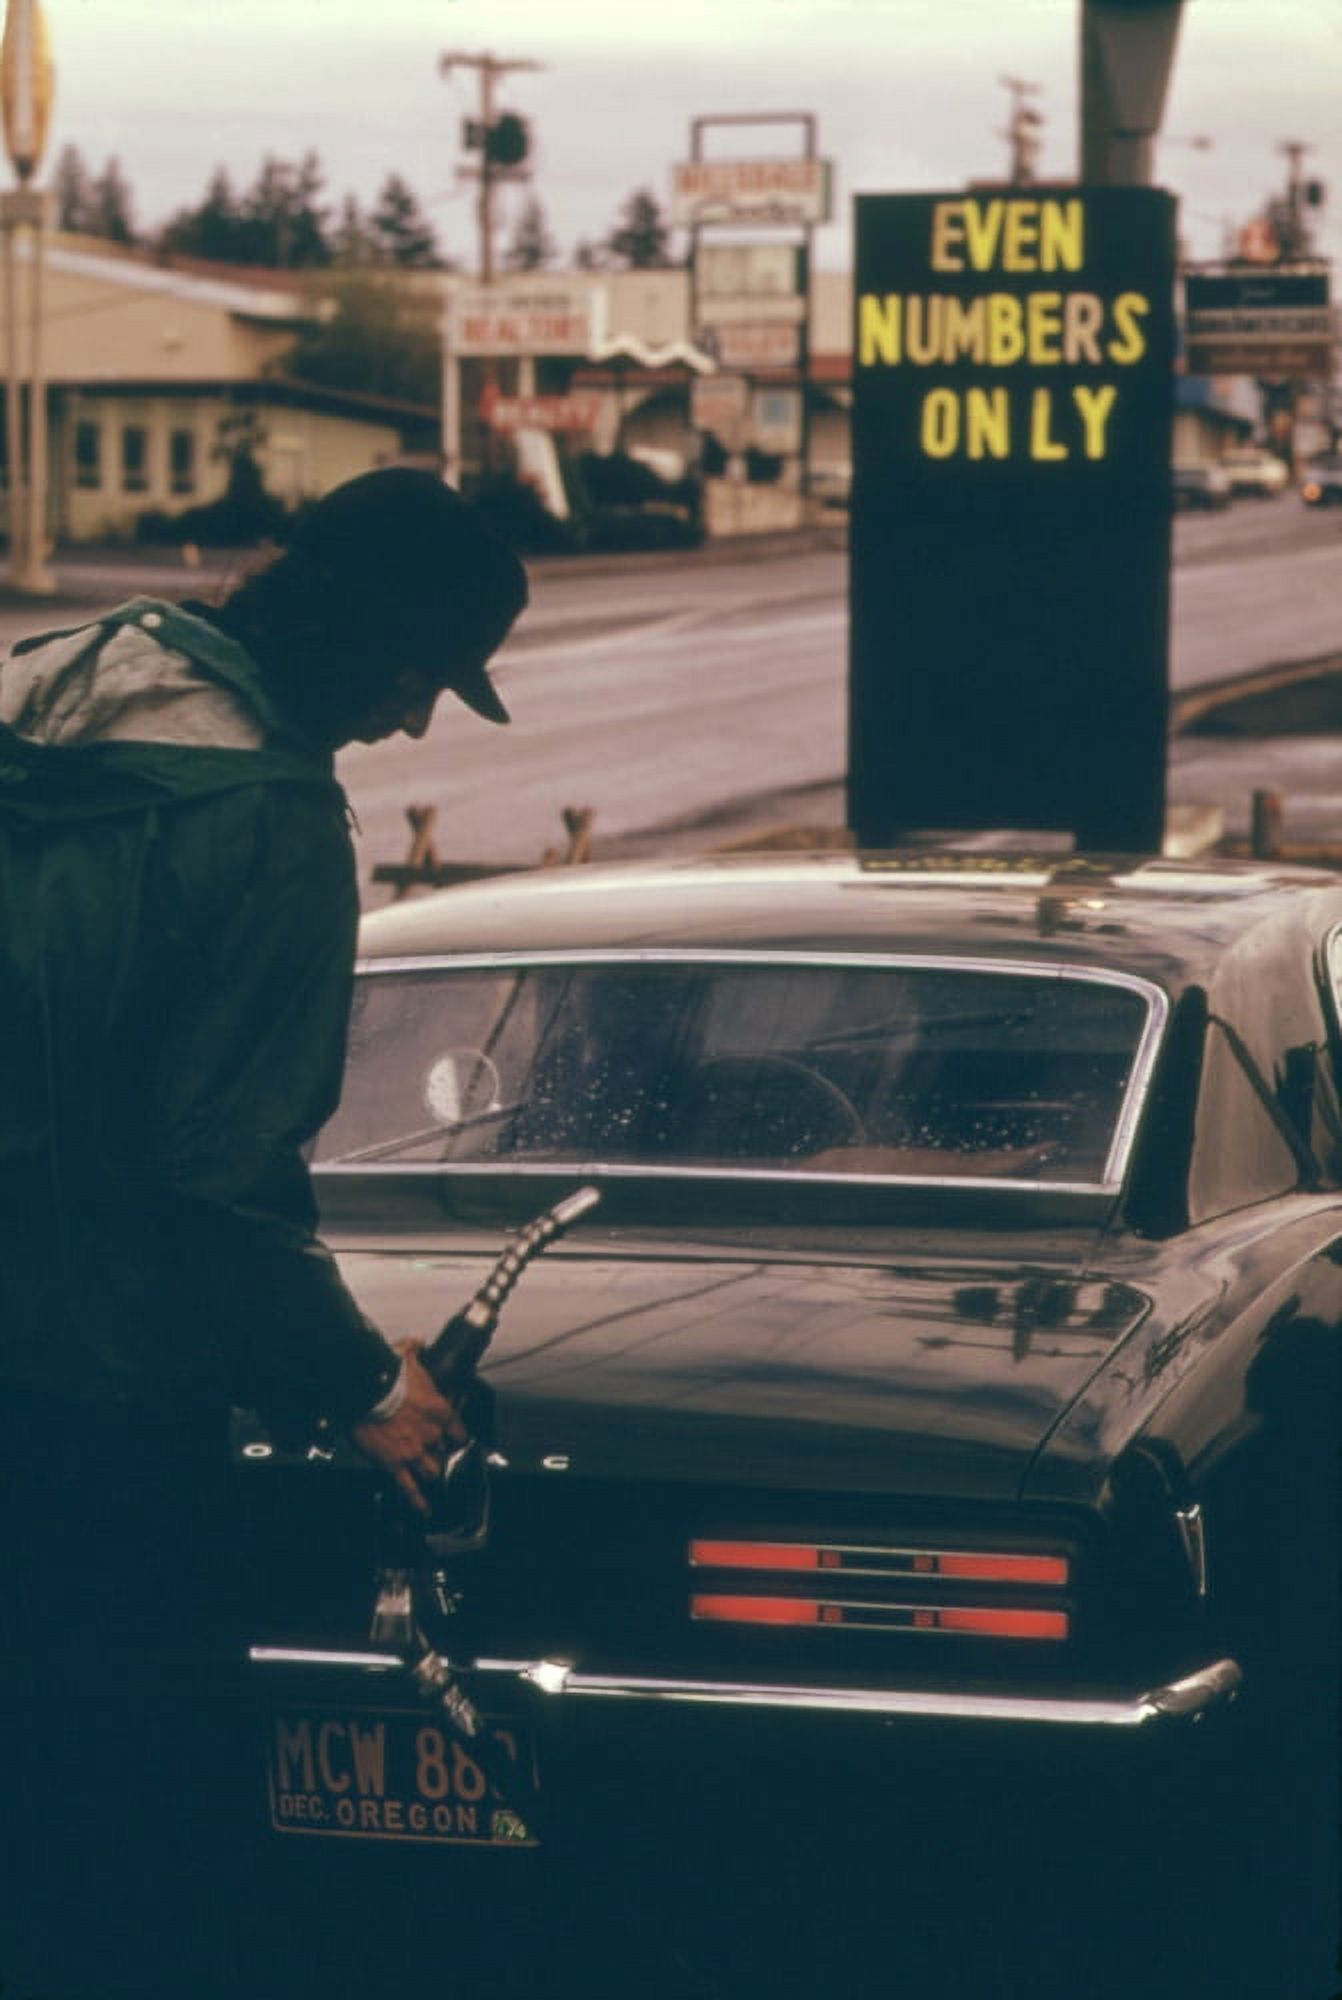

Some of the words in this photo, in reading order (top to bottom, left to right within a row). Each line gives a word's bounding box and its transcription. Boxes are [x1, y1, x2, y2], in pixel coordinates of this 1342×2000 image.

[931, 199, 1084, 273] EVEN
[859, 292, 1150, 367] NUMBERS
[921, 385, 1117, 461] ONLY
[276, 1720, 385, 1797] MCW
[336, 1800, 479, 1833] OREGON
